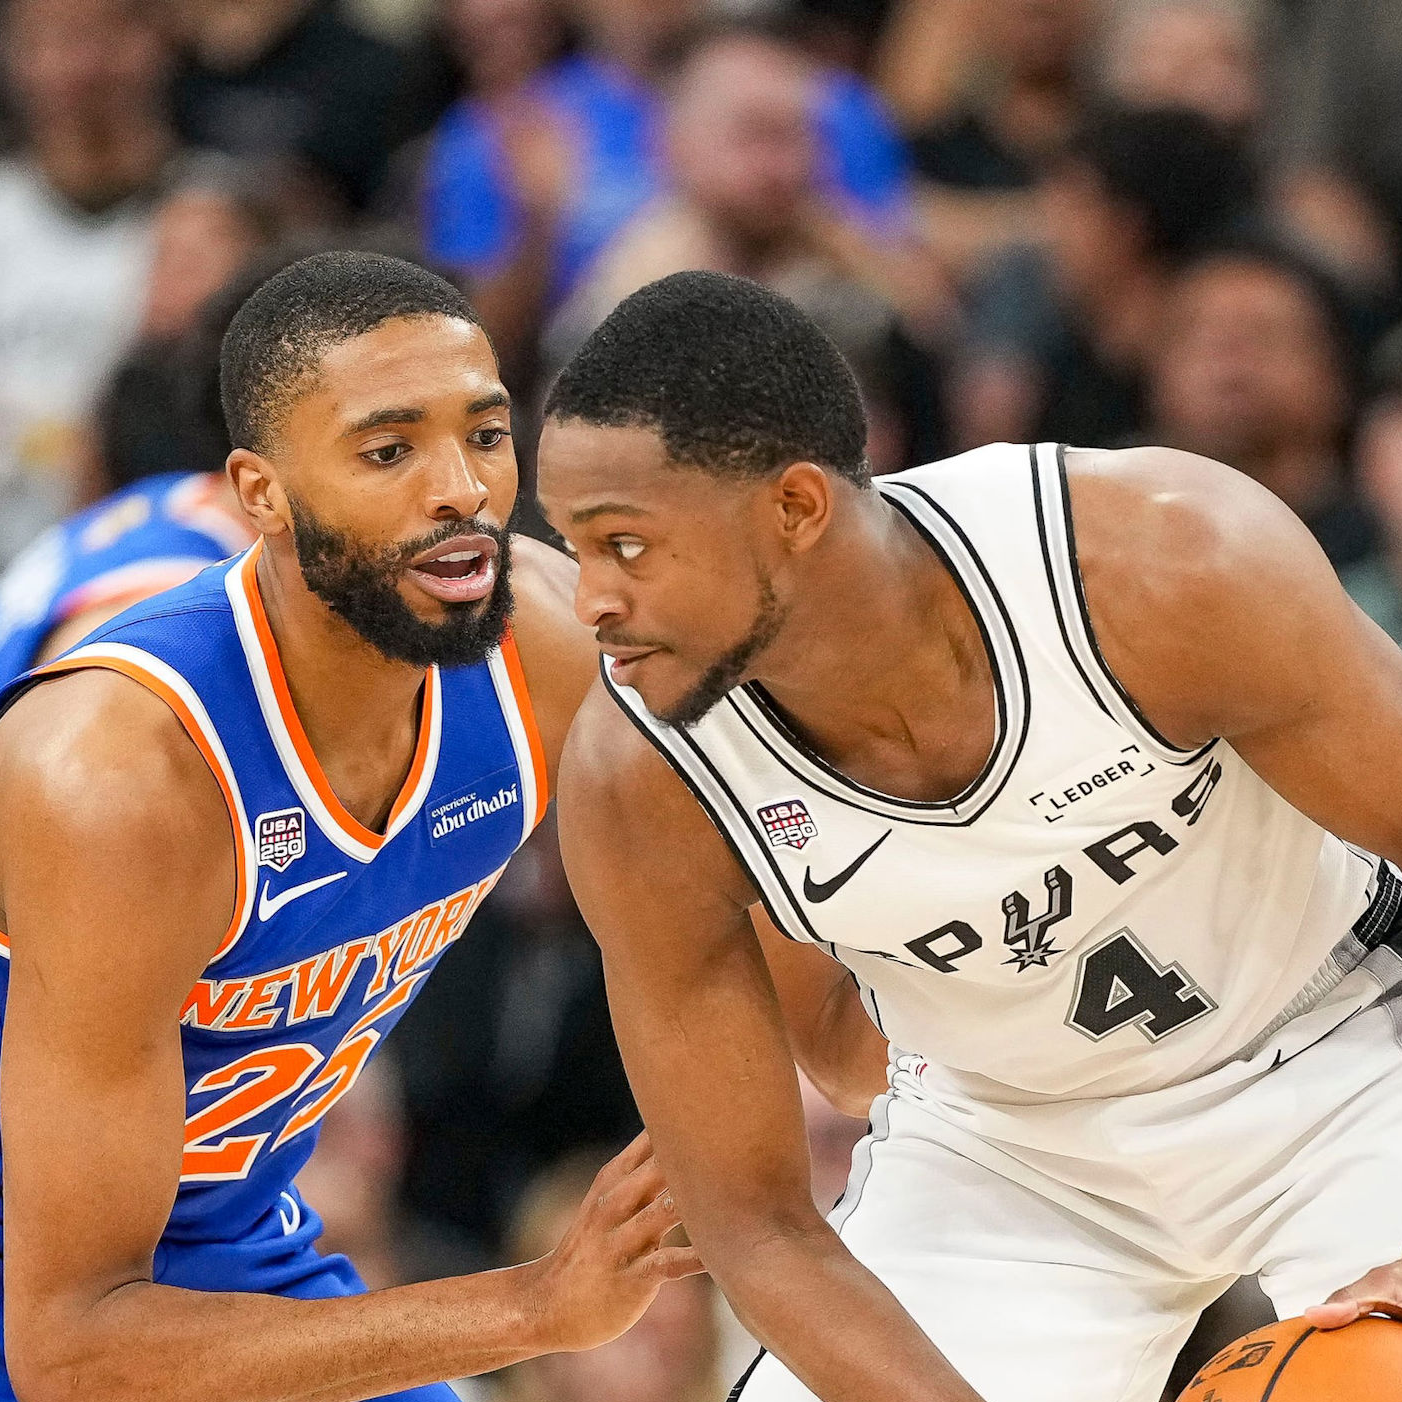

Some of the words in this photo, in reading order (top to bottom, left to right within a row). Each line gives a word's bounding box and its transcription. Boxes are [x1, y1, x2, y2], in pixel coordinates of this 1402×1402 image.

[1049, 760, 1136, 810] LEDGER
[431, 792, 477, 817] experience
[432, 811, 466, 839] abu
[466, 783, 518, 823] dhabi
[760, 803, 807, 823] USA
[262, 816, 300, 836] USA
[768, 822, 818, 847] 250
[260, 838, 302, 861] 250
[179, 934, 376, 1032] NEW
[1064, 926, 1219, 1044] 4
